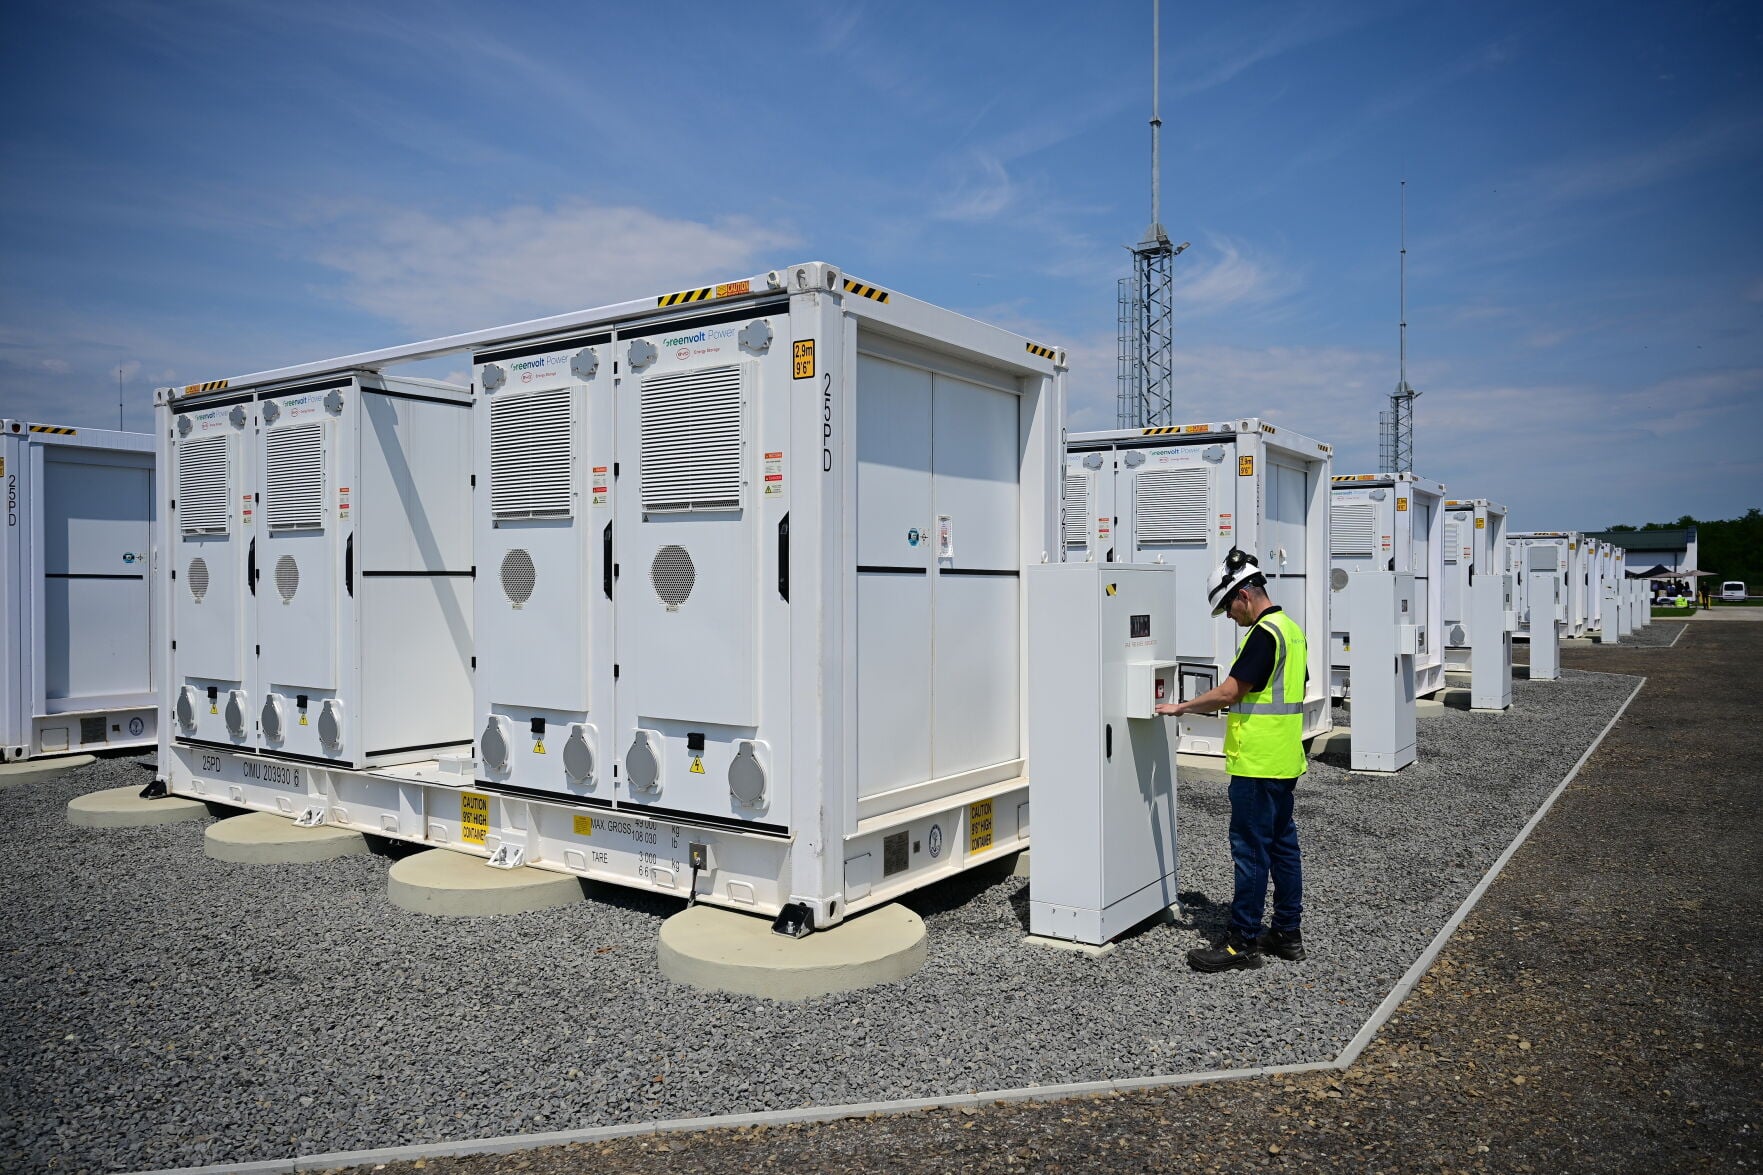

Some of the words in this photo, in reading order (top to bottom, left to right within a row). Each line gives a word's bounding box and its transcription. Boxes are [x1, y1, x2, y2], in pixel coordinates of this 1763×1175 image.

[663, 332, 705, 347] Greenvolt
[708, 328, 735, 340] Power
[511, 357, 544, 371] Greenvolt
[547, 355, 568, 365] Power
[823, 372, 832, 472] 25PD
[203, 755, 221, 772] 25PD
[263, 765, 290, 784] 203930
[463, 796, 486, 811] CAUTION
[972, 802, 991, 819] CAUTION
[473, 813, 487, 826] HIGH
[981, 817, 991, 832] HIGH
[607, 821, 632, 834] GROSS
[671, 824, 680, 838] kg
[645, 832, 657, 845] 030
[972, 833, 991, 851] CONTAINER
[592, 851, 608, 864] TARE
[645, 852, 657, 865] 000
[671, 857, 680, 873] kg
